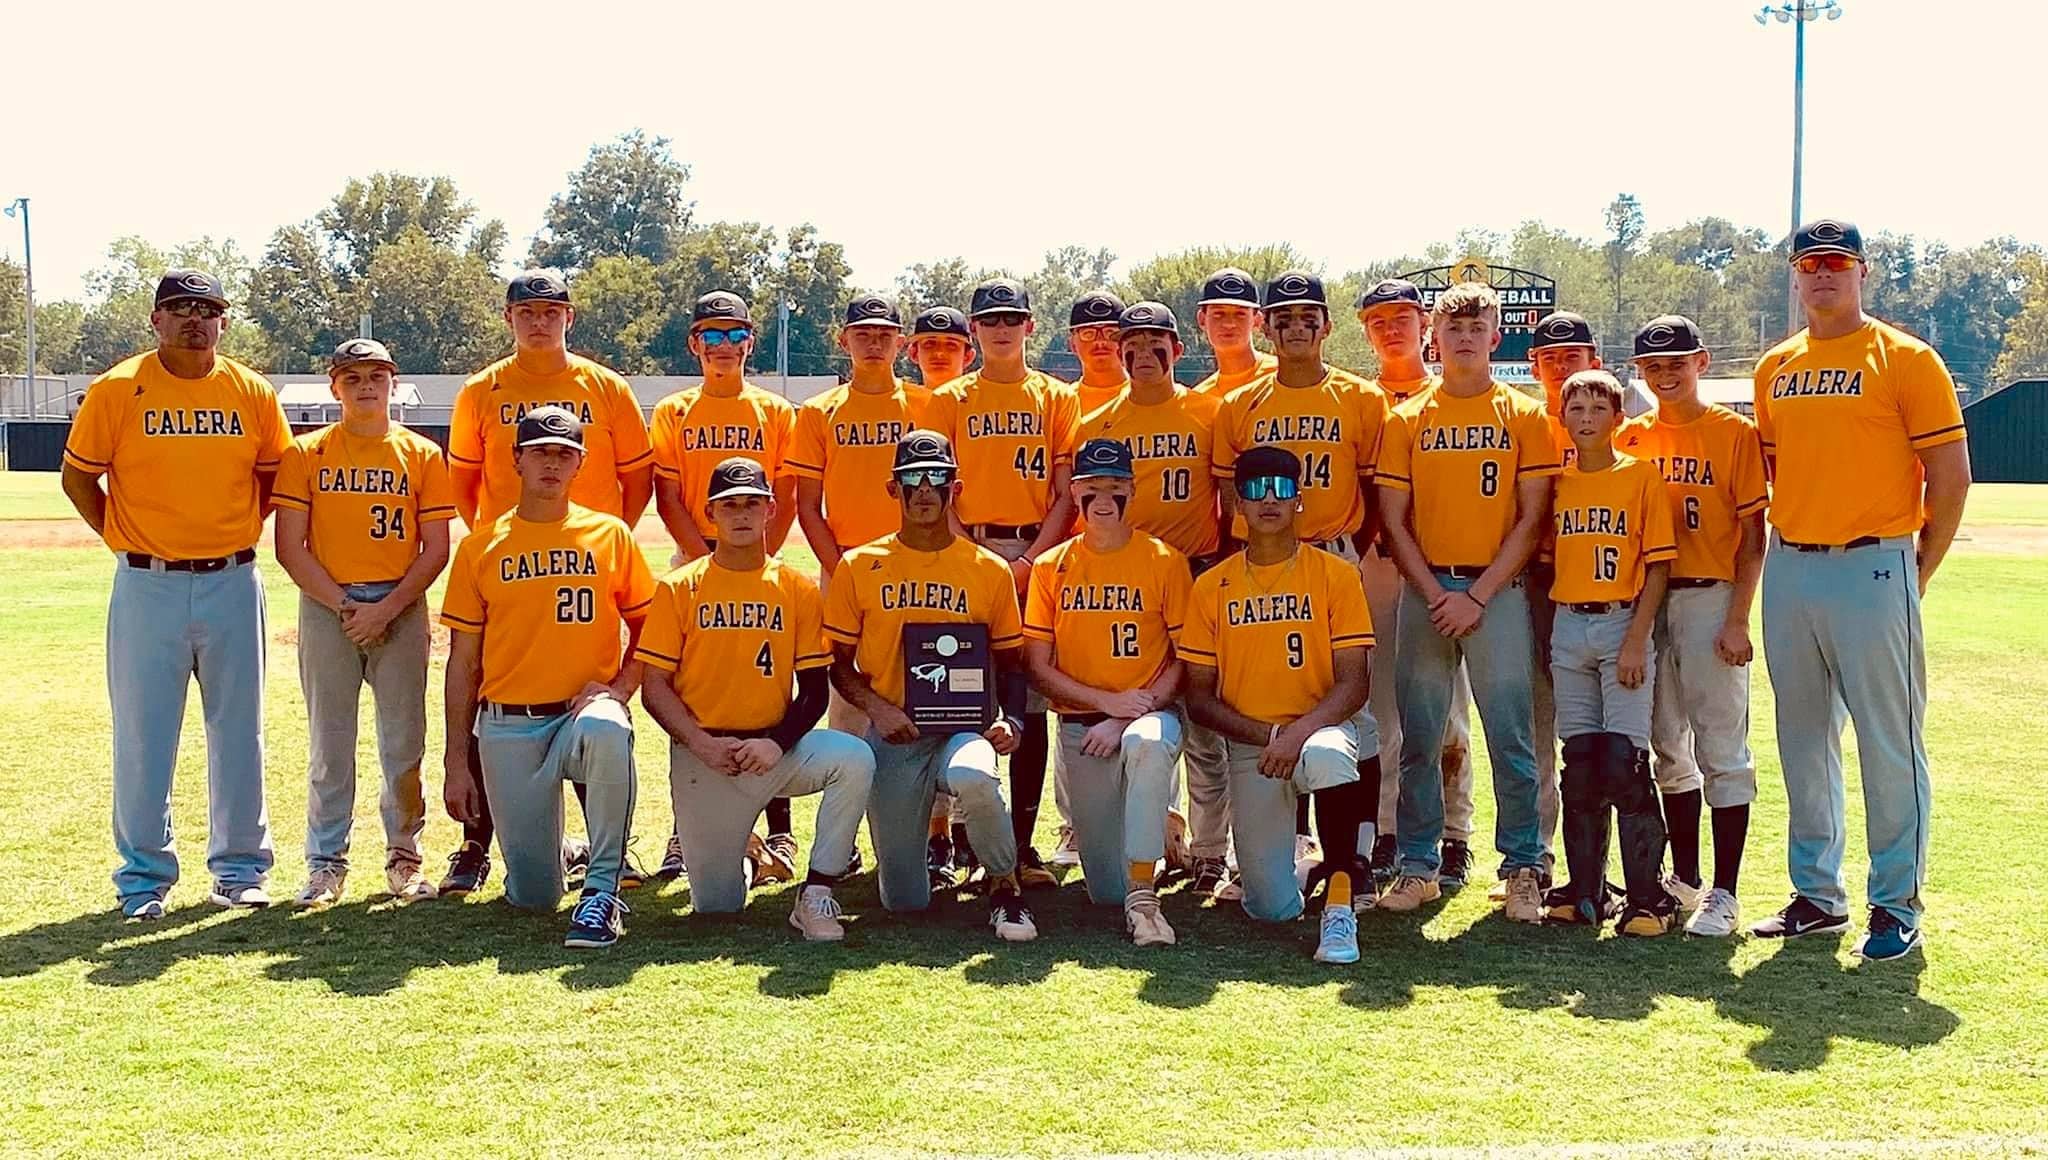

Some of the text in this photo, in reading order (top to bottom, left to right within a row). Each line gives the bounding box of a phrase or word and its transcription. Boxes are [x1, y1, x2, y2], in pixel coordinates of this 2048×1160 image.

[1807, 221, 1845, 243] C
[178, 274, 211, 293] C
[526, 276, 554, 297] C
[991, 284, 1015, 302] C
[1215, 273, 1246, 295] C
[1276, 274, 1309, 296] C
[1375, 279, 1402, 297] C
[709, 297, 735, 314] C
[857, 297, 889, 317] C
[1084, 296, 1113, 317] C
[1126, 305, 1153, 322] C
[1504, 312, 1527, 323] OUT
[927, 311, 952, 330] C
[1545, 319, 1575, 340] C
[345, 341, 372, 358] C
[1642, 325, 1676, 347] C
[1772, 369, 1863, 398] CALERA
[143, 409, 246, 437] CALERA
[499, 400, 594, 425] CAA
[539, 413, 571, 435] C
[682, 426, 765, 451] CALERA
[1254, 415, 1342, 443] CALERA
[1420, 424, 1512, 452] CALERA
[908, 437, 940, 458] C
[1086, 444, 1119, 464] C
[1124, 432, 1198, 460] ALERA
[722, 463, 755, 485] C
[1013, 446, 1046, 481] 44
[1302, 452, 1332, 488] 14
[1651, 456, 1714, 486] LERA
[317, 467, 412, 497] CALERA
[1160, 468, 1192, 501] 10
[1479, 460, 1499, 498] 8
[369, 504, 406, 540] 34
[1554, 507, 1628, 536] ALERA
[1684, 495, 1702, 531] 6
[500, 549, 597, 583] CALERA
[1593, 544, 1620, 582] 16
[555, 587, 594, 625] 20
[879, 583, 970, 614] CALERA
[1060, 584, 1144, 613] CALERA
[1227, 594, 1313, 628] CALERA
[698, 603, 784, 632] CALERA
[1110, 622, 1141, 659] 12
[1286, 631, 1304, 669] 9
[754, 640, 775, 678] 4
